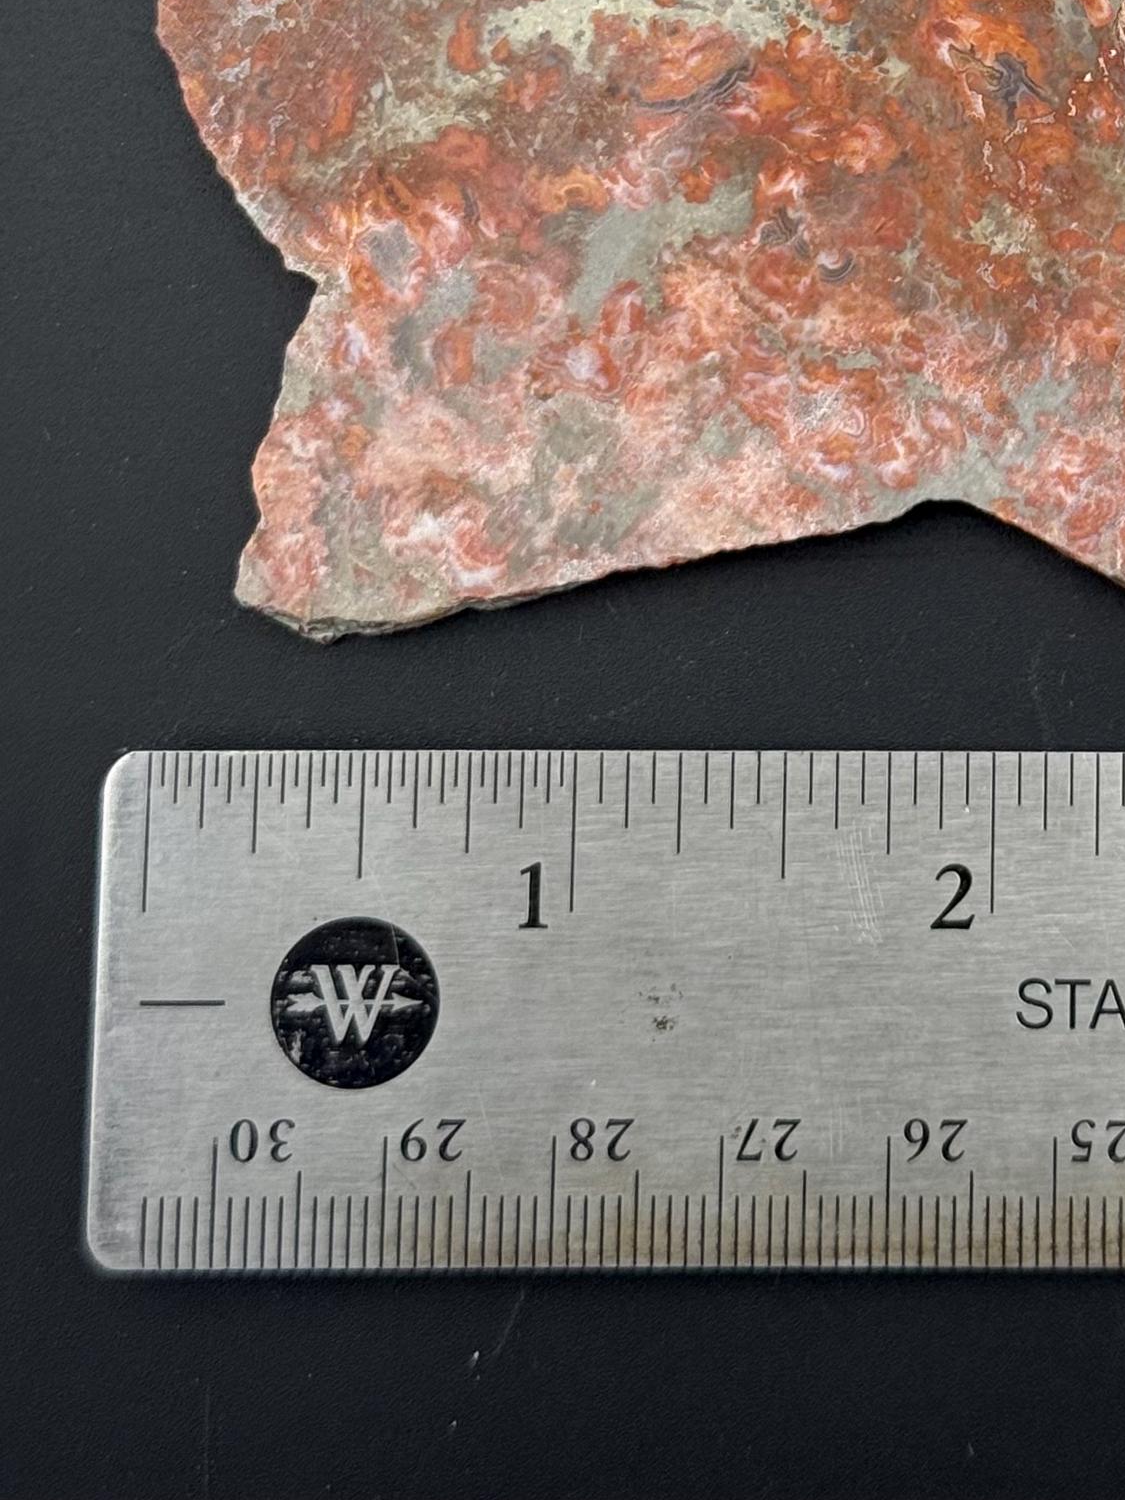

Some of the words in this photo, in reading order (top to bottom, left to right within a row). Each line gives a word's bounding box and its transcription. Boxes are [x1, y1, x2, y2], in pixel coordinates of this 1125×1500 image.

[517, 861, 549, 931] 1
[929, 862, 975, 932] 2
[230, 1118, 296, 1163] 30
[399, 1118, 468, 1163] 29
[568, 1118, 635, 1163] 28
[737, 1118, 802, 1163] 27
[902, 1117, 969, 1163] 26
